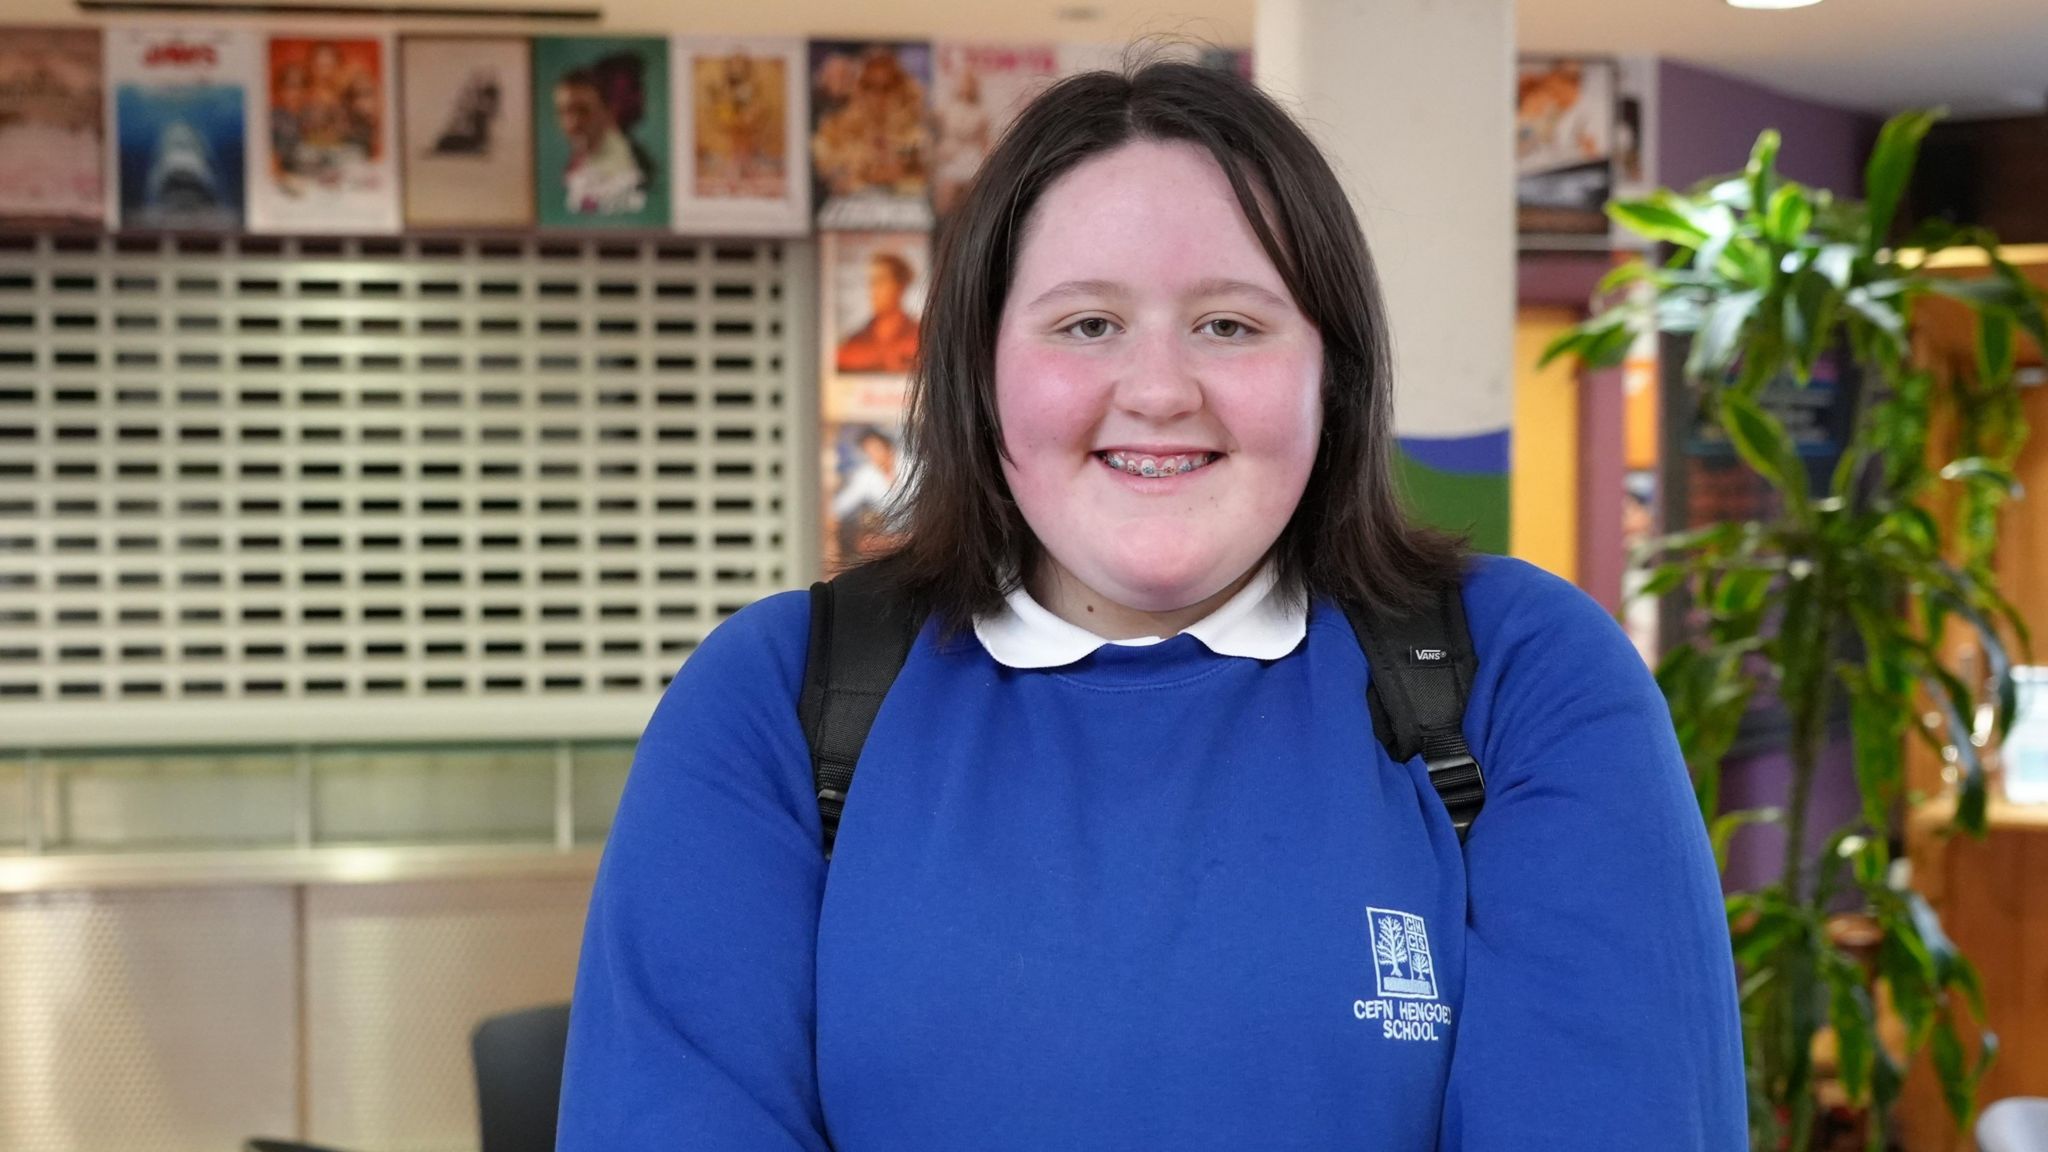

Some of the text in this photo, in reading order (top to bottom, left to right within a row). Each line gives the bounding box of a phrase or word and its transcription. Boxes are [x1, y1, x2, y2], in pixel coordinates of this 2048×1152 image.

[1416, 649, 1441, 660] VANS
[1353, 1000, 1394, 1020] CEFN
[1383, 1019, 1438, 1041] SCHOOL
